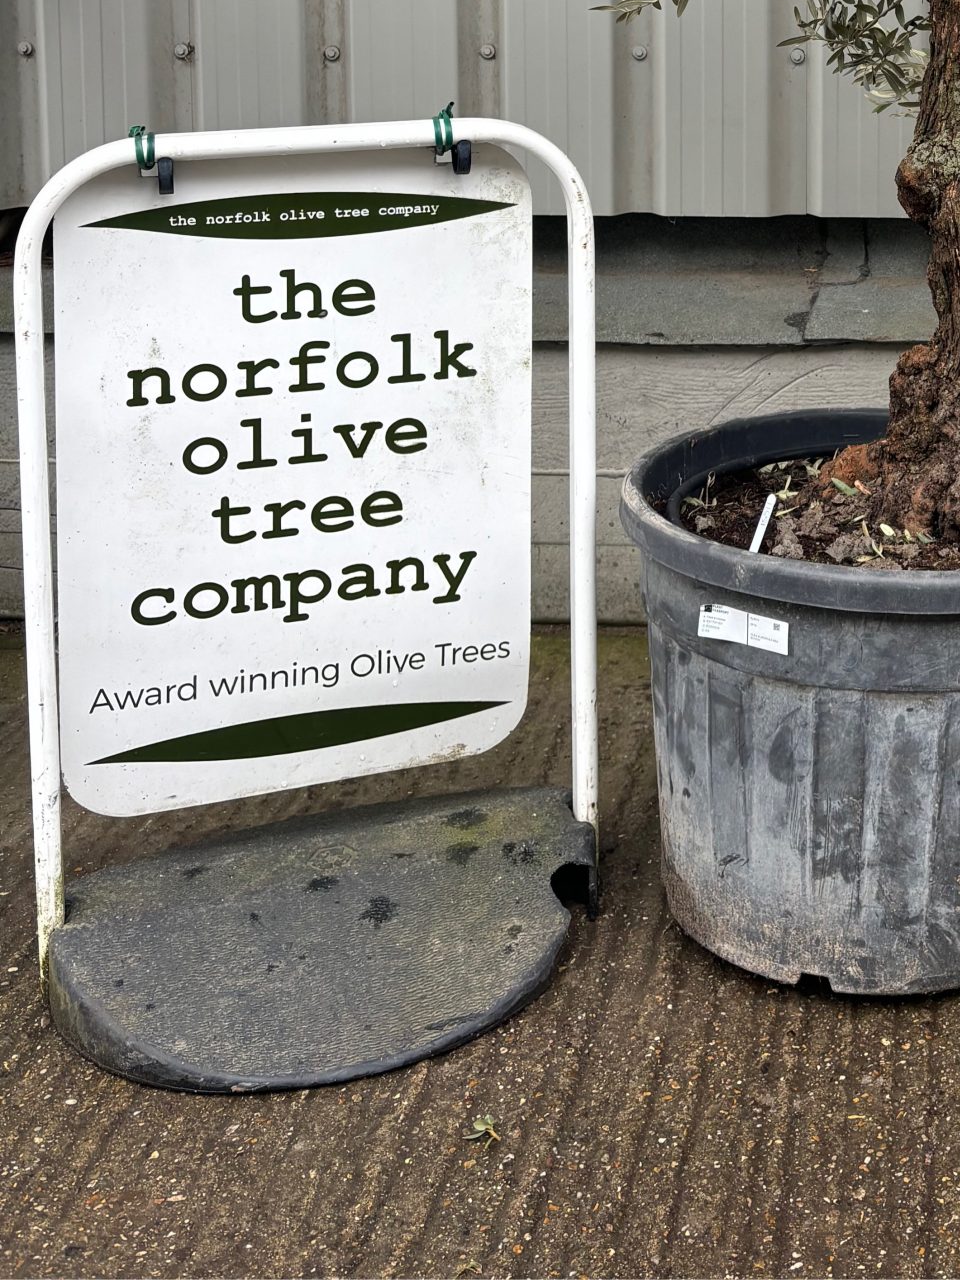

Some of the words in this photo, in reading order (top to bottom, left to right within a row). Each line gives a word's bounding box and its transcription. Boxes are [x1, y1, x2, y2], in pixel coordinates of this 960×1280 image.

[169, 214, 197, 227] the
[205, 210, 271, 226] norfolk
[279, 208, 326, 222] olive
[334, 206, 370, 219] tree
[378, 203, 440, 218] company
[232, 268, 376, 324] the
[126, 329, 478, 407] norfolk
[182, 413, 428, 475] olive
[211, 490, 403, 545] tree
[130, 550, 478, 626] company
[89, 674, 198, 715] Award
[208, 661, 341, 698] winning
[350, 649, 427, 678] Olive
[434, 641, 511, 668] Trees
